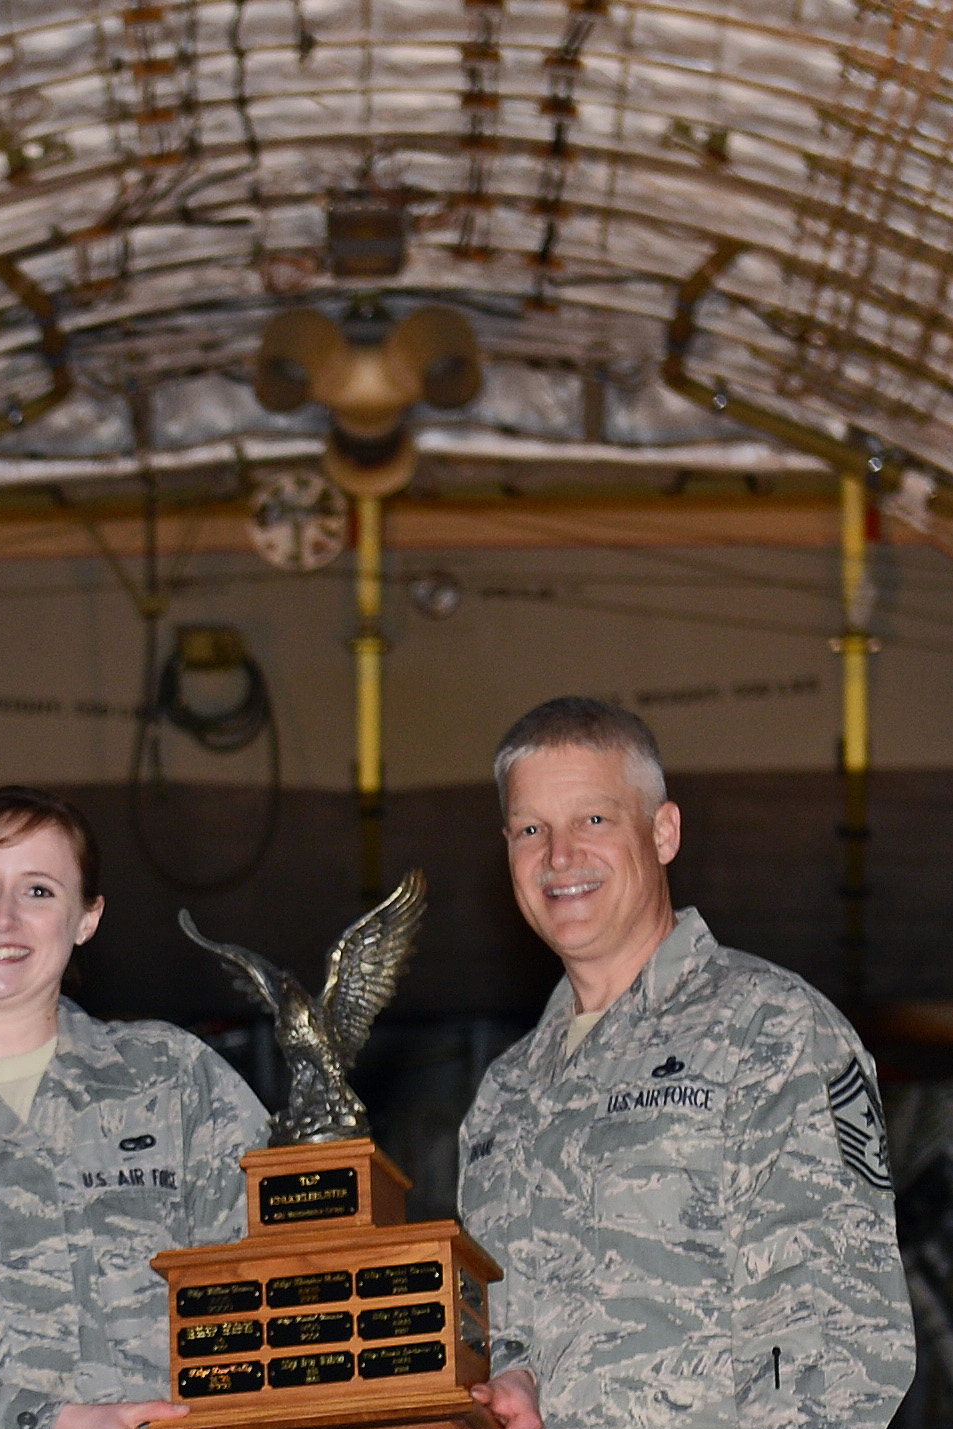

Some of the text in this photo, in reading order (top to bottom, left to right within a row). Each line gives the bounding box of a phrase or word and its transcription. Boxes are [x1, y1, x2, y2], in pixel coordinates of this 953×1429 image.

[634, 1089, 661, 1109] AIR
[663, 1085, 715, 1111] FORCE
[116, 1168, 145, 1187] AIR
